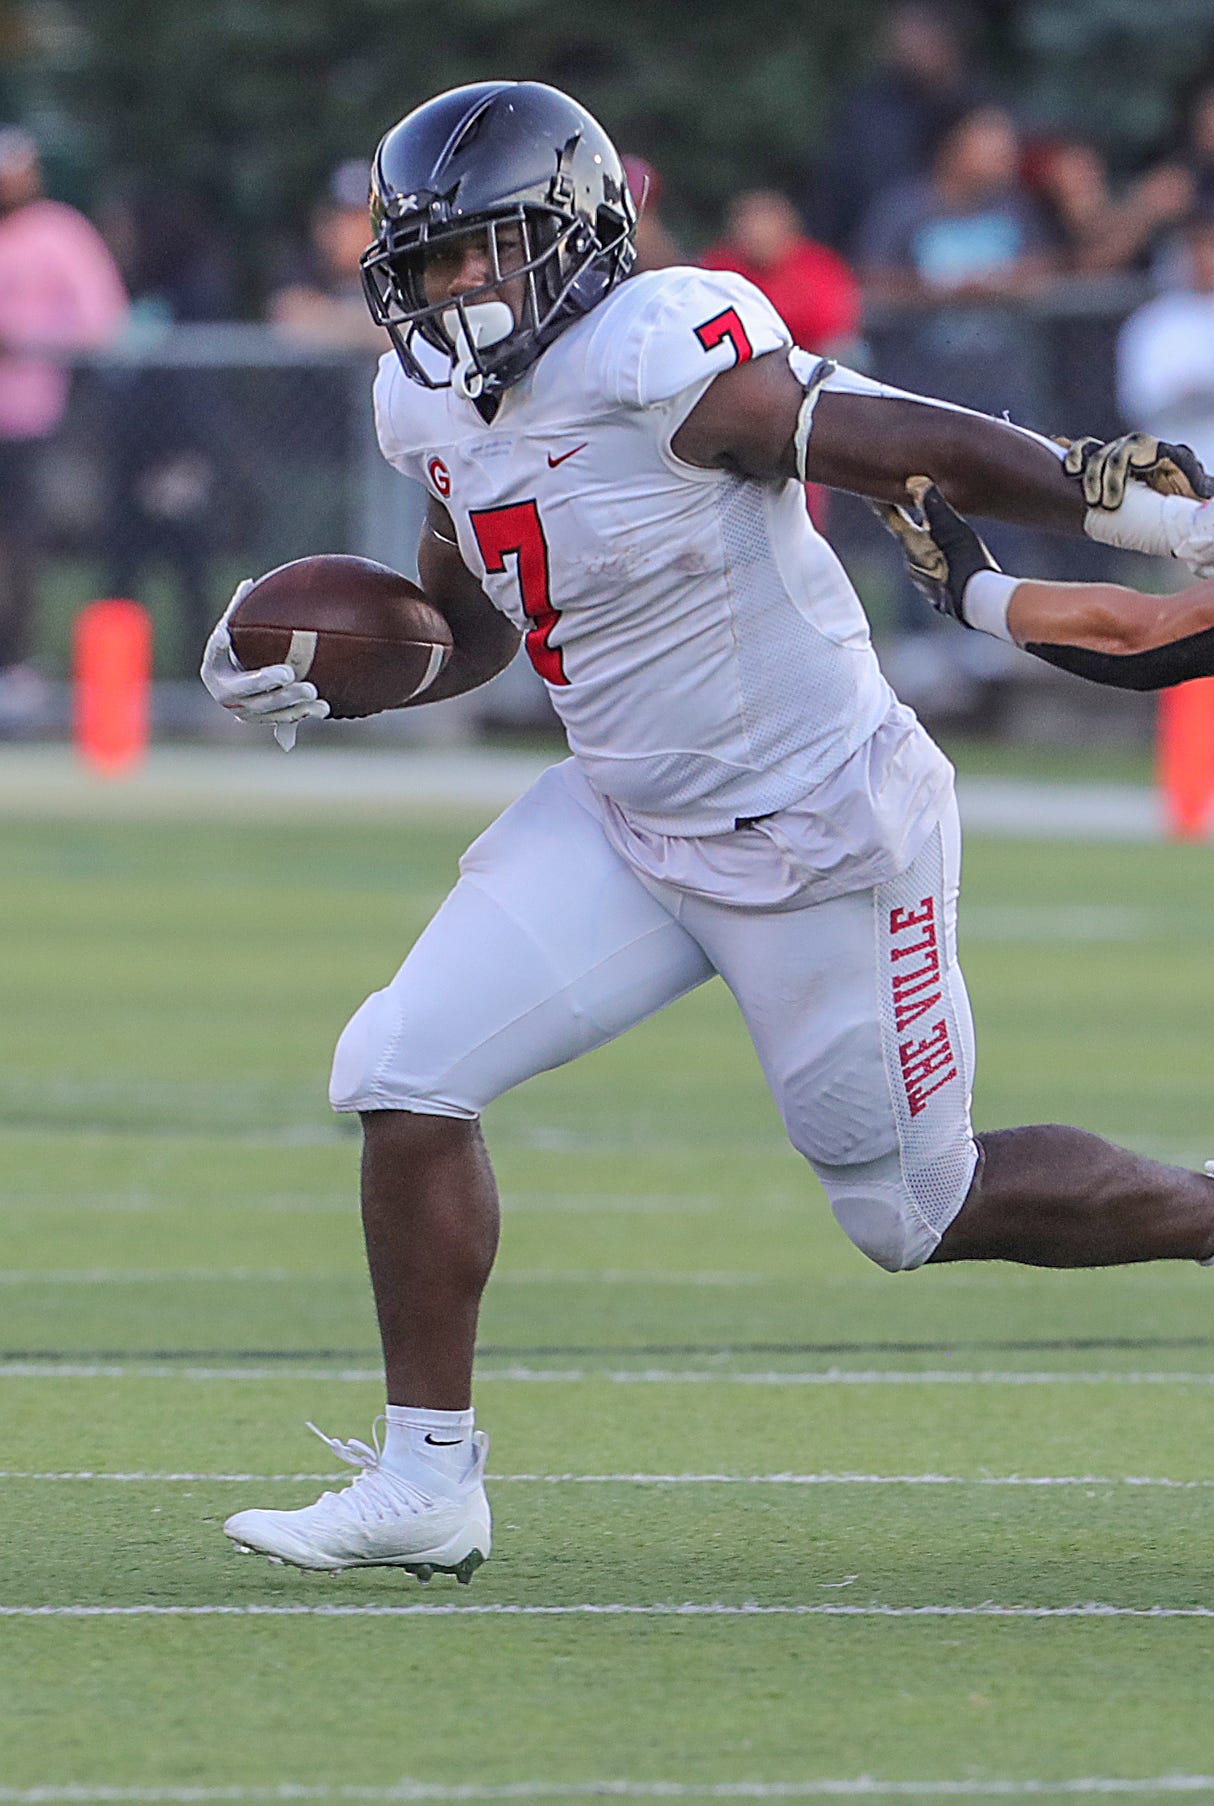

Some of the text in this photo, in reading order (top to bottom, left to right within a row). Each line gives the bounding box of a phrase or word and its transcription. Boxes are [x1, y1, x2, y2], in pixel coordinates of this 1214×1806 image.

[693, 305, 754, 368] 7
[427, 455, 451, 499] G
[468, 498, 573, 686] 7
[889, 896, 958, 1118] THE VILLE
